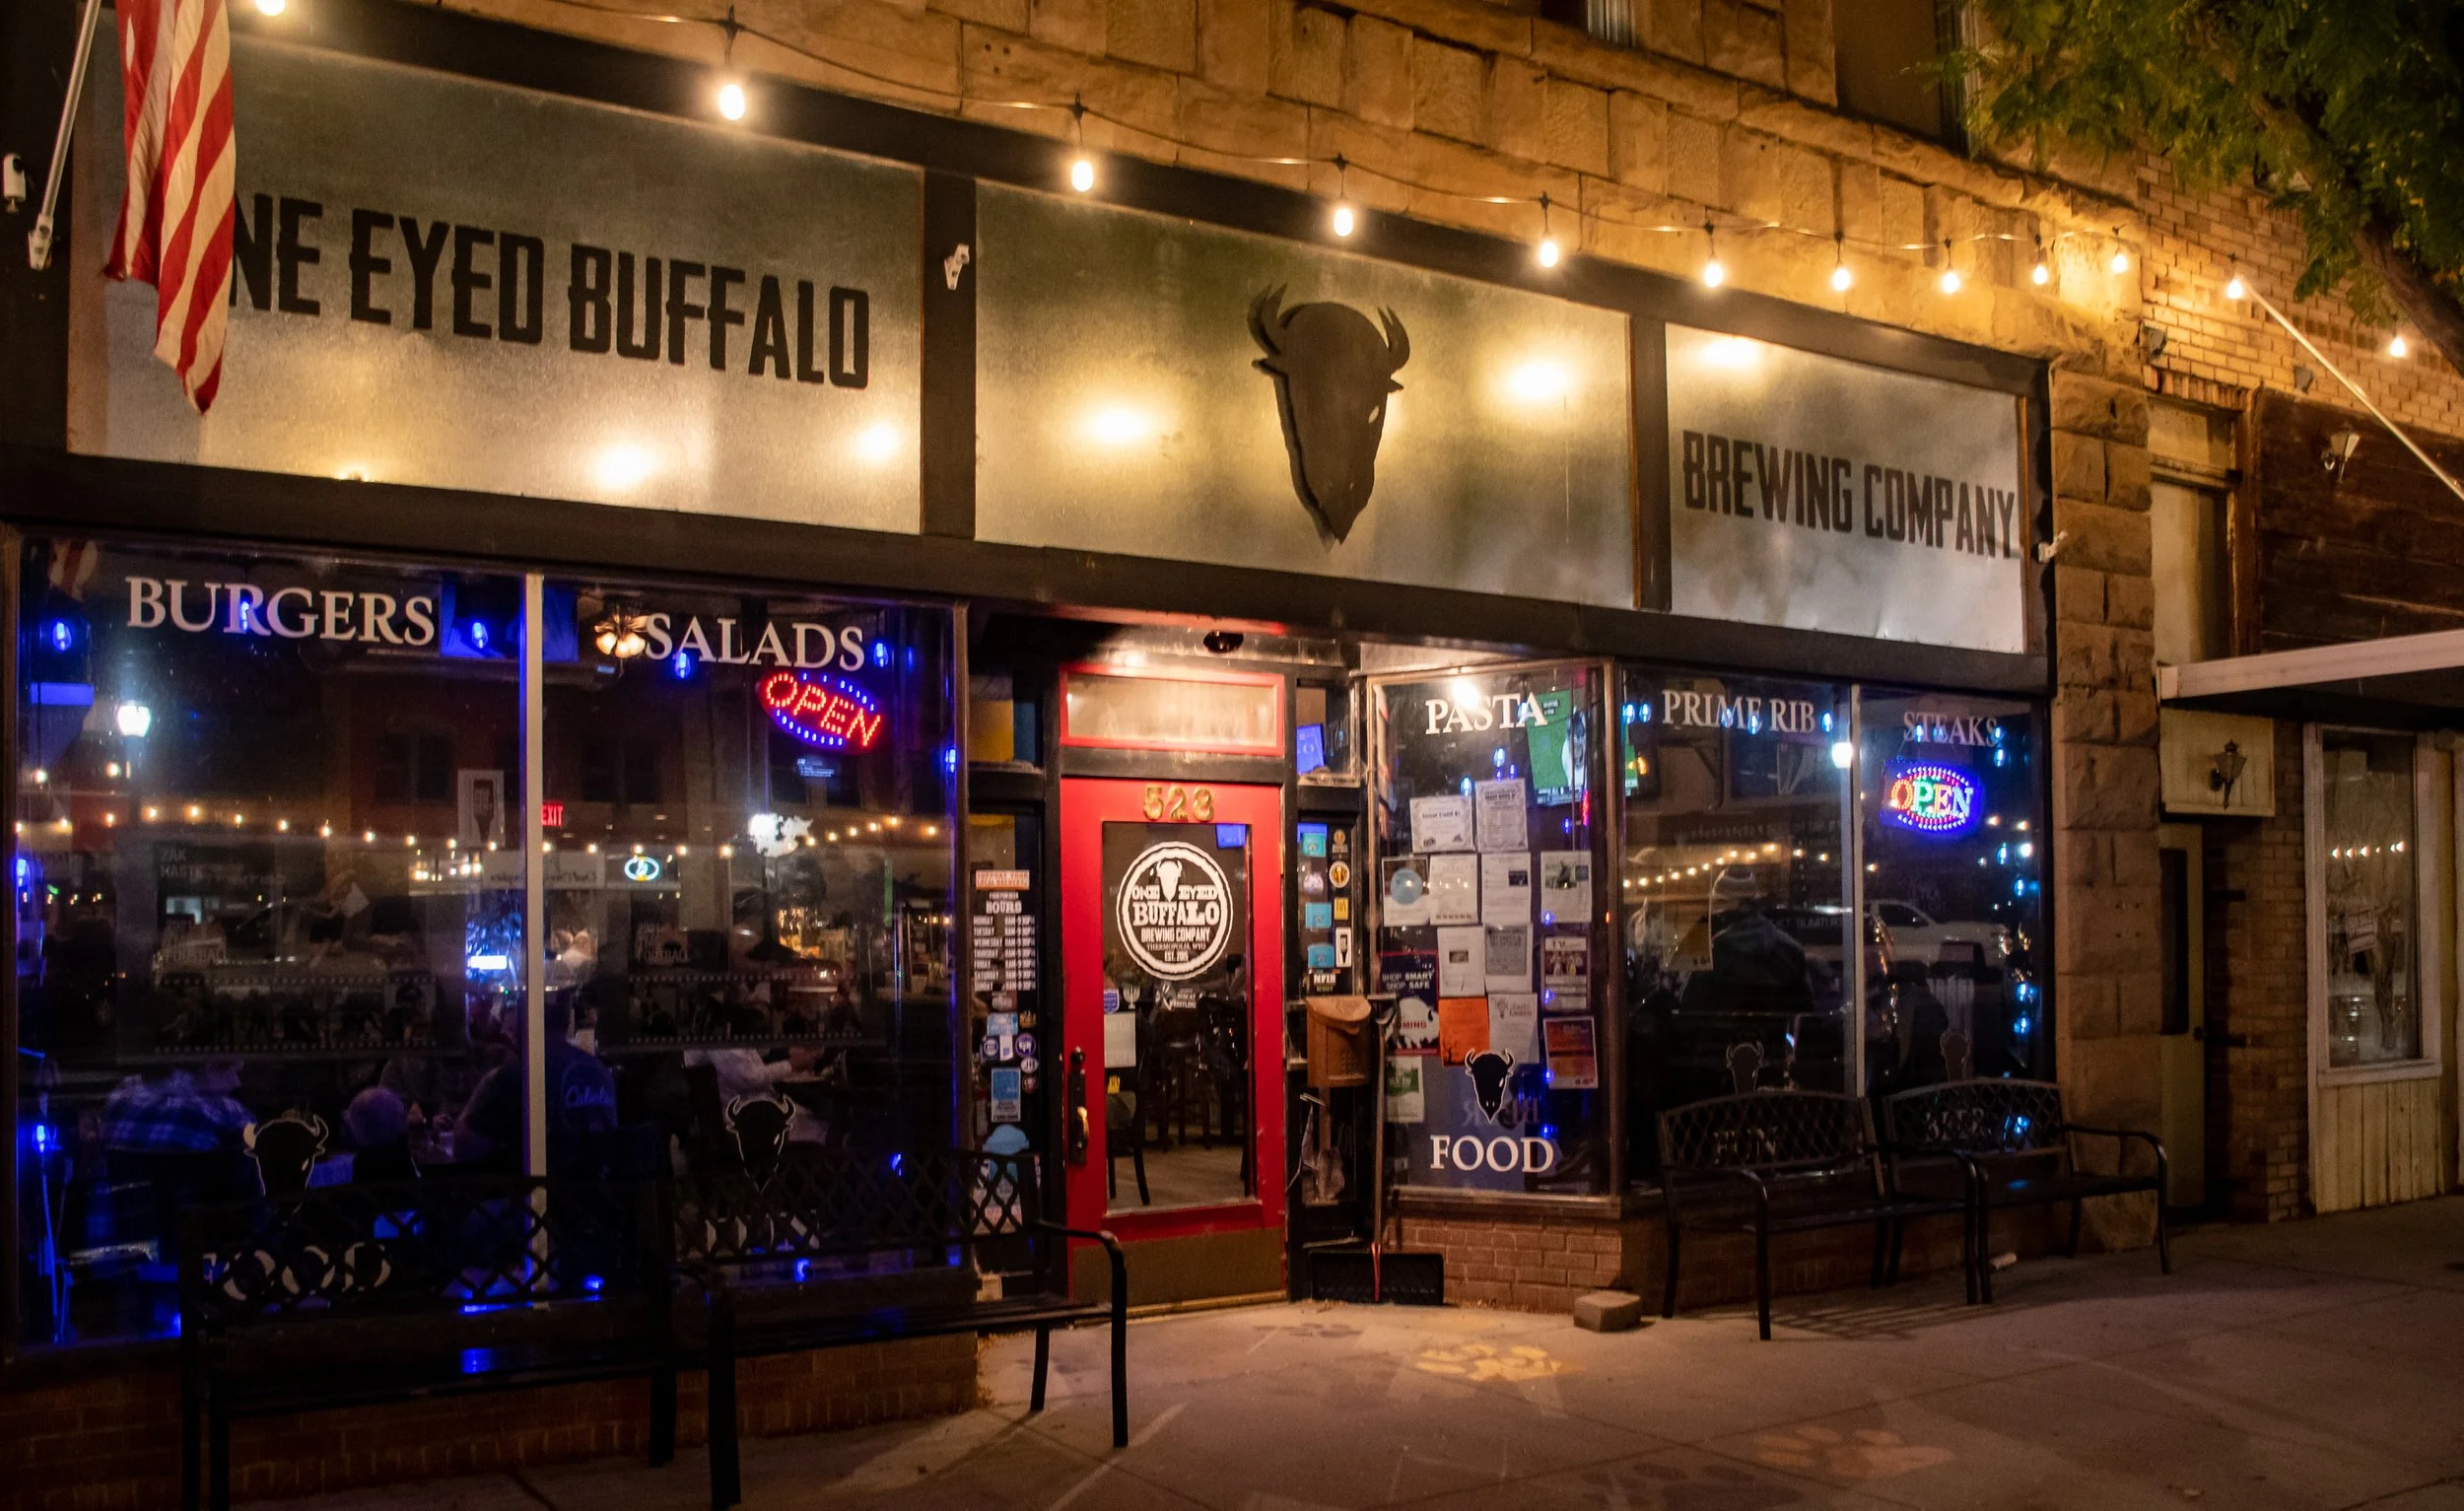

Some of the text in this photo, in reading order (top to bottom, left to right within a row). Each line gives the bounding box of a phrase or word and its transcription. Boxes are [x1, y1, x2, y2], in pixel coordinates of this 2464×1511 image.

[229, 193, 870, 389] NE EYED BUFFALO
[1681, 430, 2016, 559] BREWING COMPANY
[124, 576, 436, 647] BURGERS
[645, 612, 864, 671] SALADS
[766, 672, 881, 746] OPEN
[1425, 692, 1547, 735] PASTA
[1662, 689, 1815, 732] PRIME RIB
[1903, 712, 1999, 747] STEAKS
[1143, 786, 1215, 823] 528
[1889, 777, 1973, 817] OPEN
[986, 900, 1022, 914] HOURS
[1131, 885, 1217, 900] ONE EYED
[1132, 901, 1220, 926] BUFFALO
[1141, 927, 1210, 942] BREWING COMPANY
[1430, 1134, 1554, 1173] FOOD
